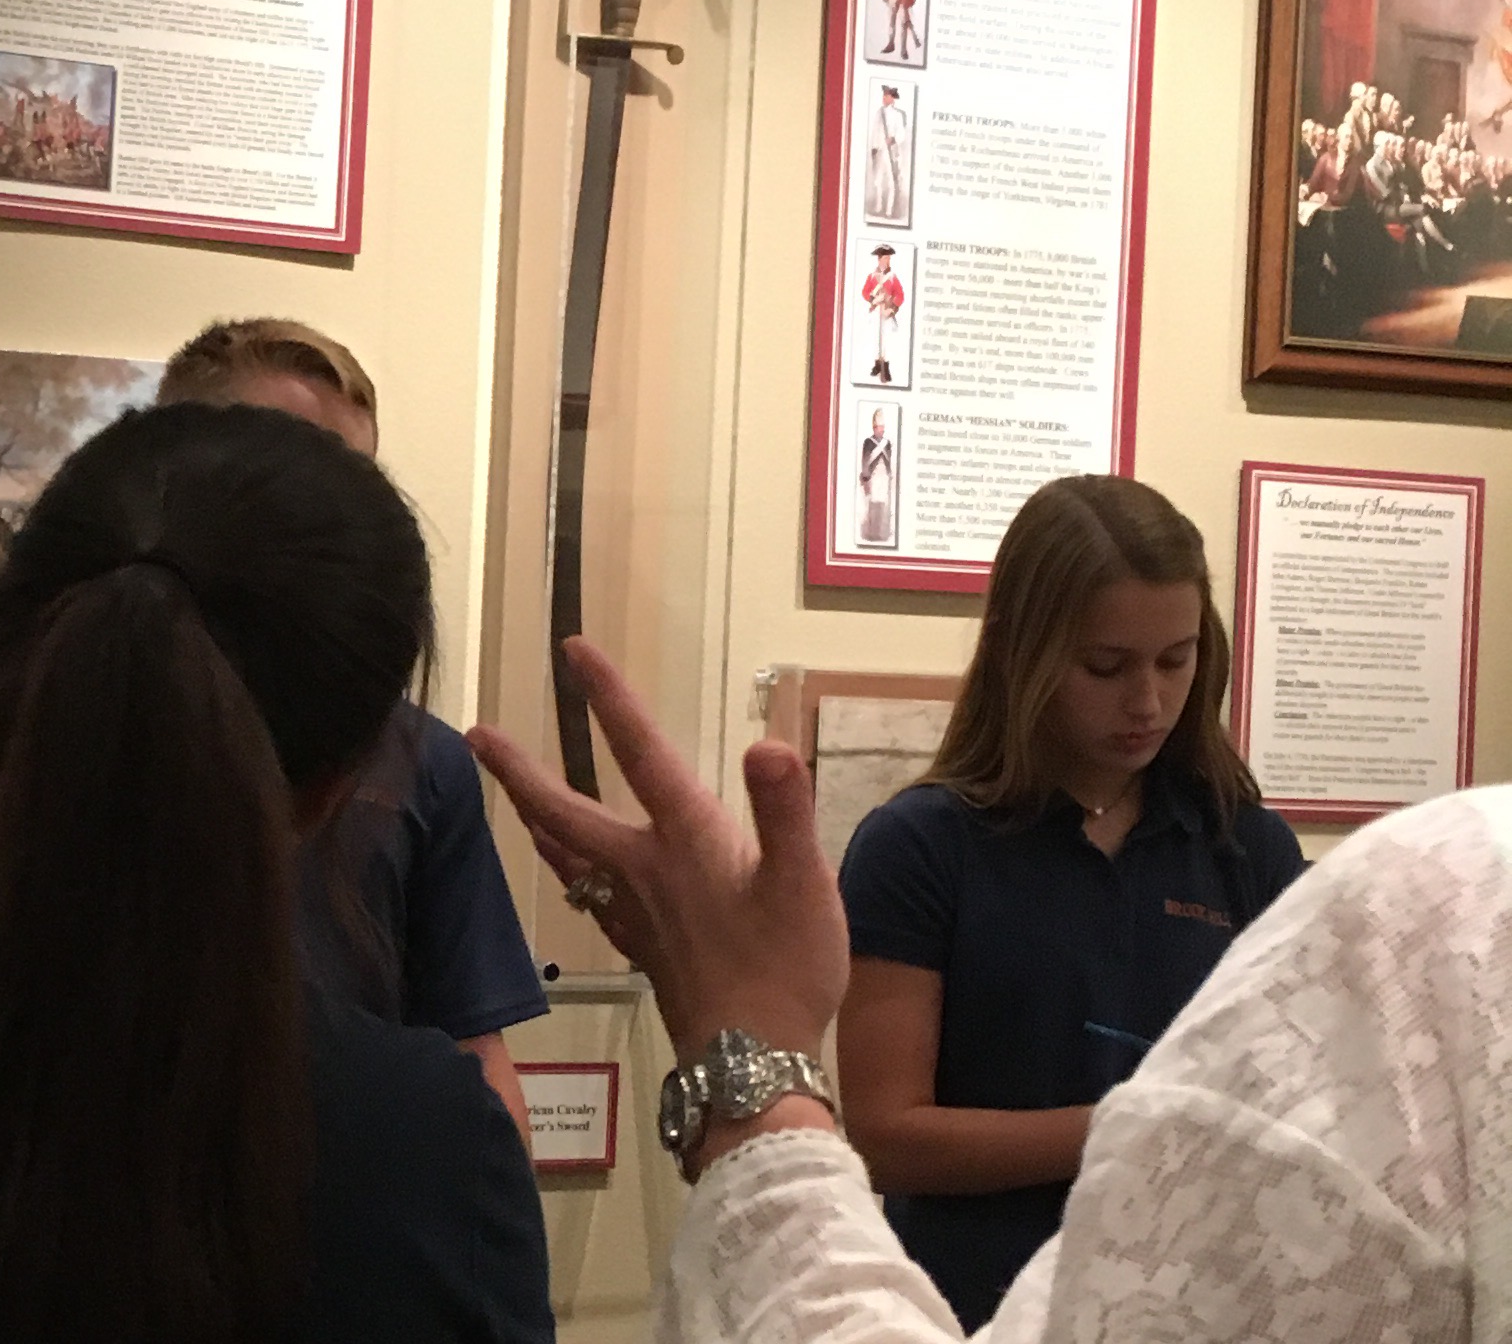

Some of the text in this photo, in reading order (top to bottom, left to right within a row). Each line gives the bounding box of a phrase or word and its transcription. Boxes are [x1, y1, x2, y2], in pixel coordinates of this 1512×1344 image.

[932, 111, 973, 125] FRENCH
[926, 240, 966, 254] BRITISH
[918, 412, 963, 425] GERMAN
[1276, 487, 1456, 523] Declaration of Independence
